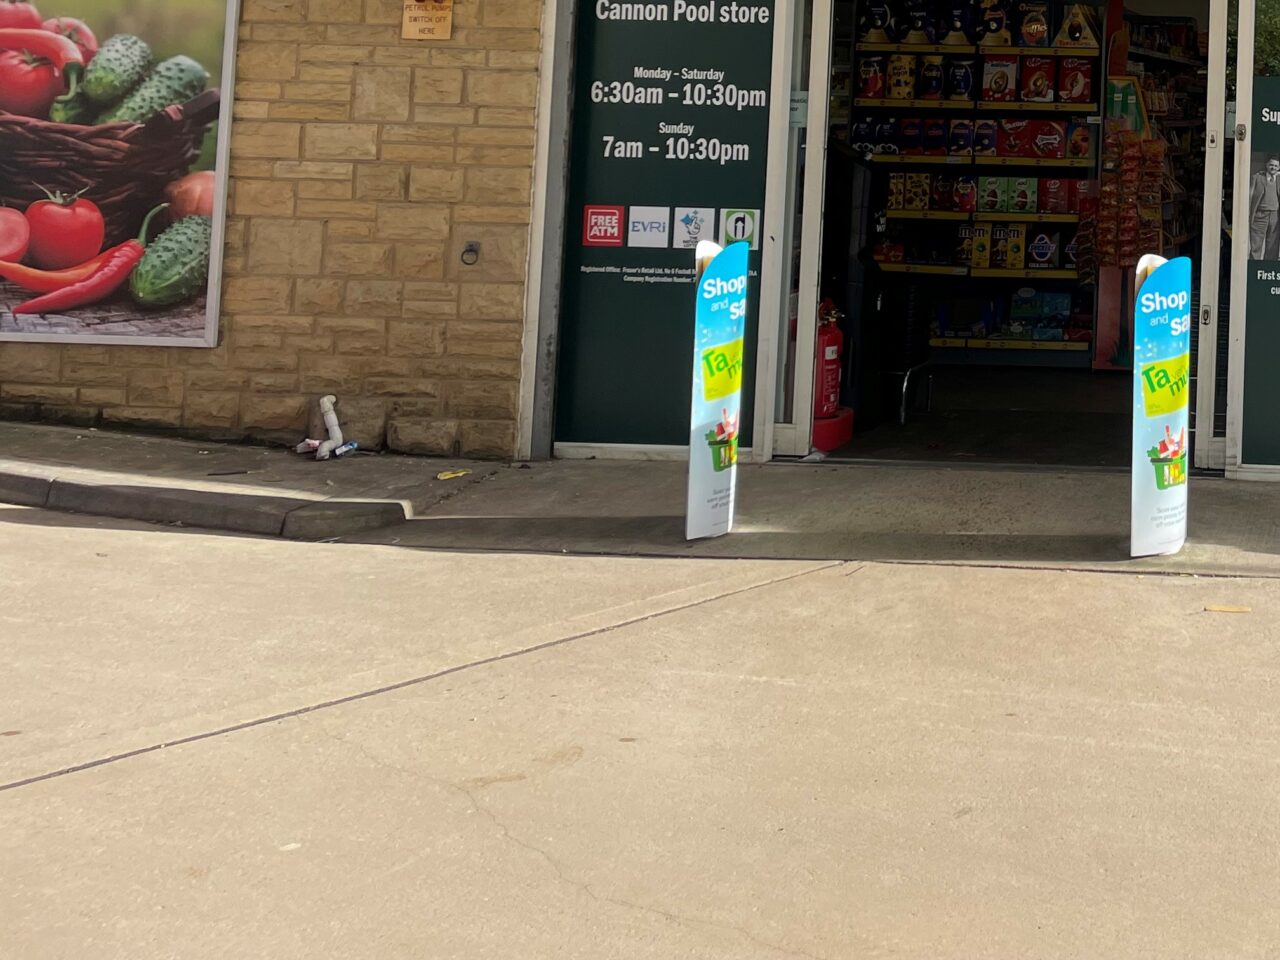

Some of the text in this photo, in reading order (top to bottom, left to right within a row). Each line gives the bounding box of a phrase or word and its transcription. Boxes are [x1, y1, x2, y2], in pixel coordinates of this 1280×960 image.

[404, 4, 452, 12] PETROL PUMPS
[673, 0, 715, 23] Pool
[719, 2, 770, 25] store
[408, 15, 433, 23] SWITCH
[418, 27, 436, 35] HERE
[633, 66, 673, 81] Monday
[681, 67, 725, 82] Saturday
[590, 81, 663, 105] 6:30am
[682, 82, 766, 111] 10:30pm
[658, 121, 694, 136] Sunday
[602, 136, 643, 159] 7am
[665, 137, 749, 164] 10:30pm
[590, 215, 619, 226] FREE
[590, 226, 618, 237] ATM
[1257, 270, 1276, 281] First
[703, 274, 747, 299] Shop
[711, 298, 729, 312] and
[1141, 290, 1187, 314] Shop
[1150, 312, 1169, 327] and
[702, 349, 729, 378] Ta
[1141, 365, 1170, 394] Ta
